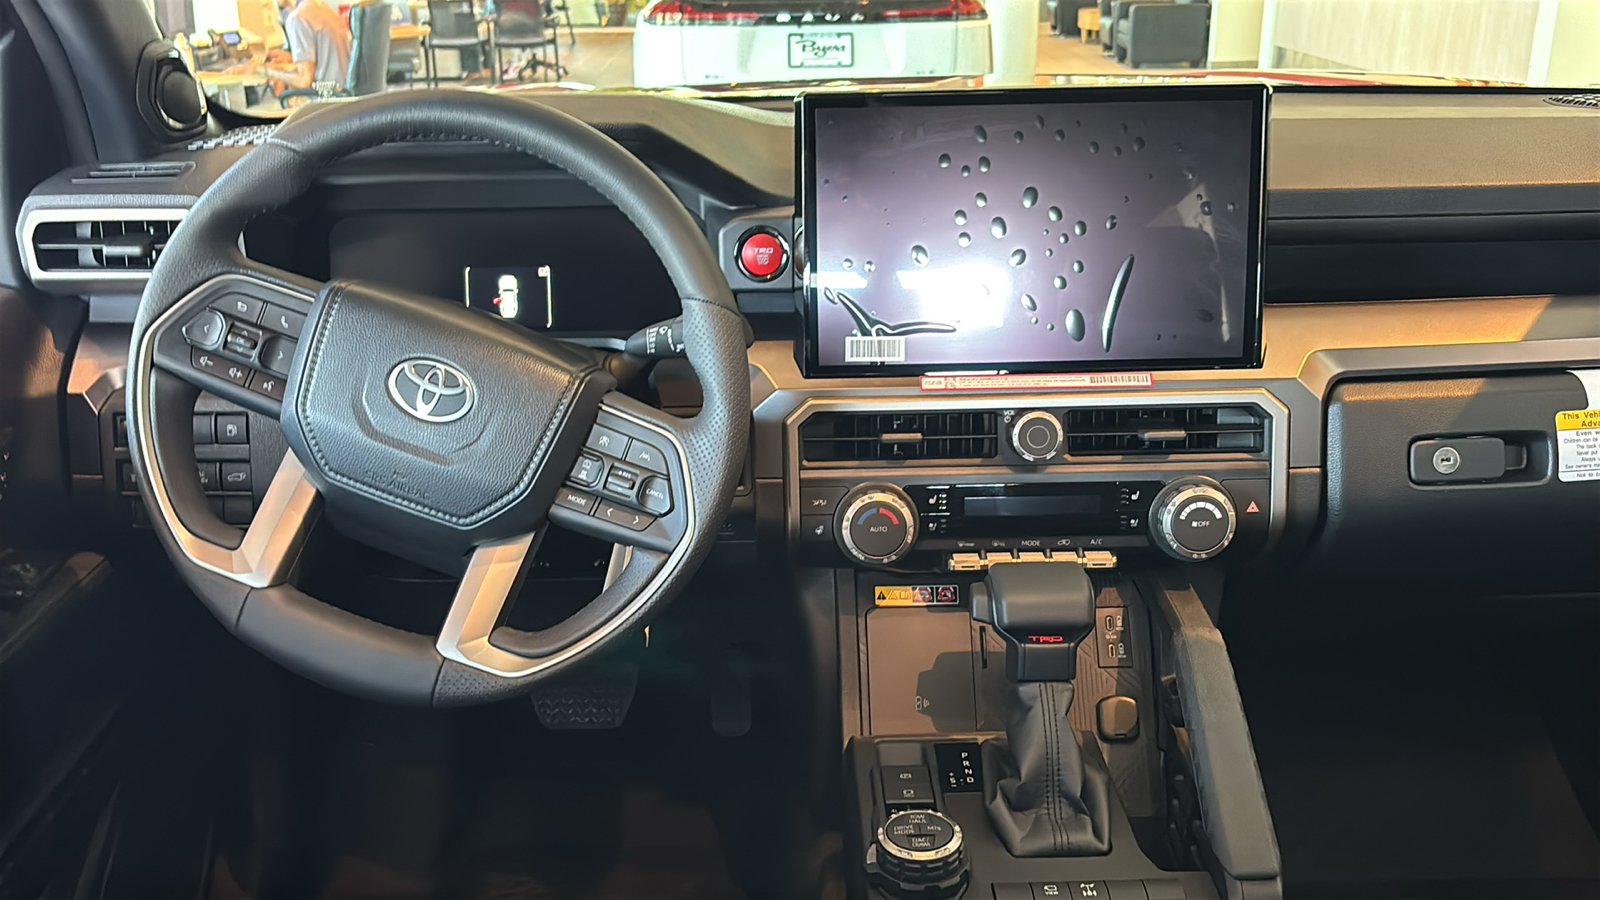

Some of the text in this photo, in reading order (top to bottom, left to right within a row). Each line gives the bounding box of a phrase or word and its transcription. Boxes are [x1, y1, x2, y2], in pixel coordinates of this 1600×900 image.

[795, 39, 846, 58] Byers
[1562, 412, 1580, 420] This
[646, 488, 663, 498] CANCEL
[568, 494, 586, 505] MODE
[1090, 538, 1102, 546] A/C
[1027, 635, 1064, 643] TRD
